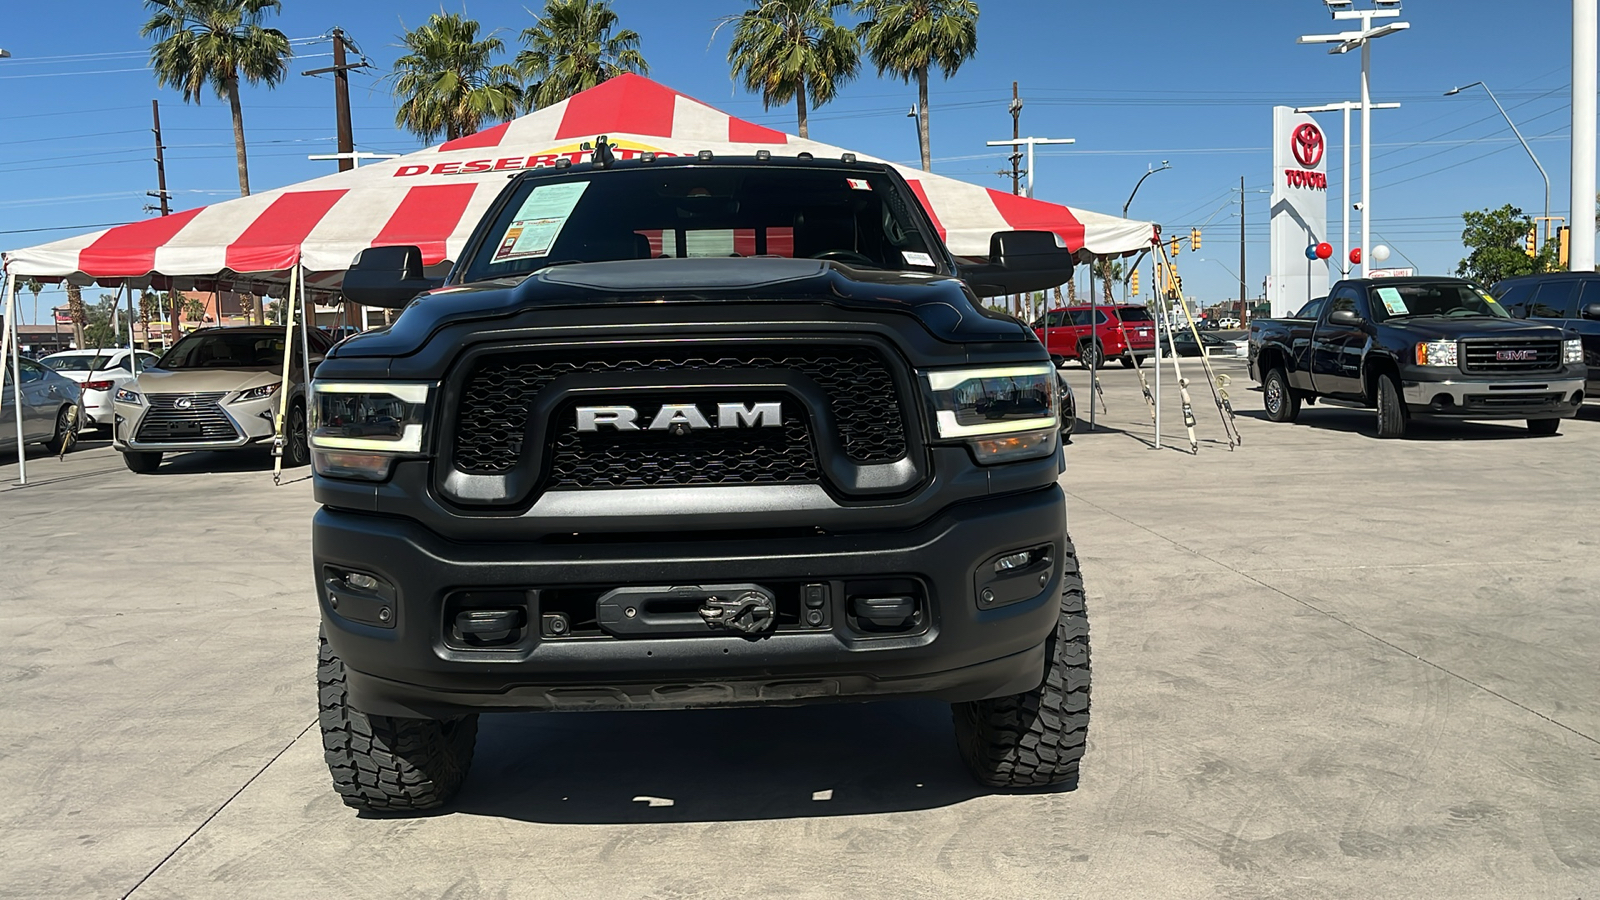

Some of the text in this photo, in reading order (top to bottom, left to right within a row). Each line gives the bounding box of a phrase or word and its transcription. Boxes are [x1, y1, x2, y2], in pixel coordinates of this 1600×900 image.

[393, 150, 594, 177] DESERT
[1285, 169, 1327, 188] TOYOTA
[1496, 350, 1537, 360] GMC
[576, 402, 782, 431] RAM
